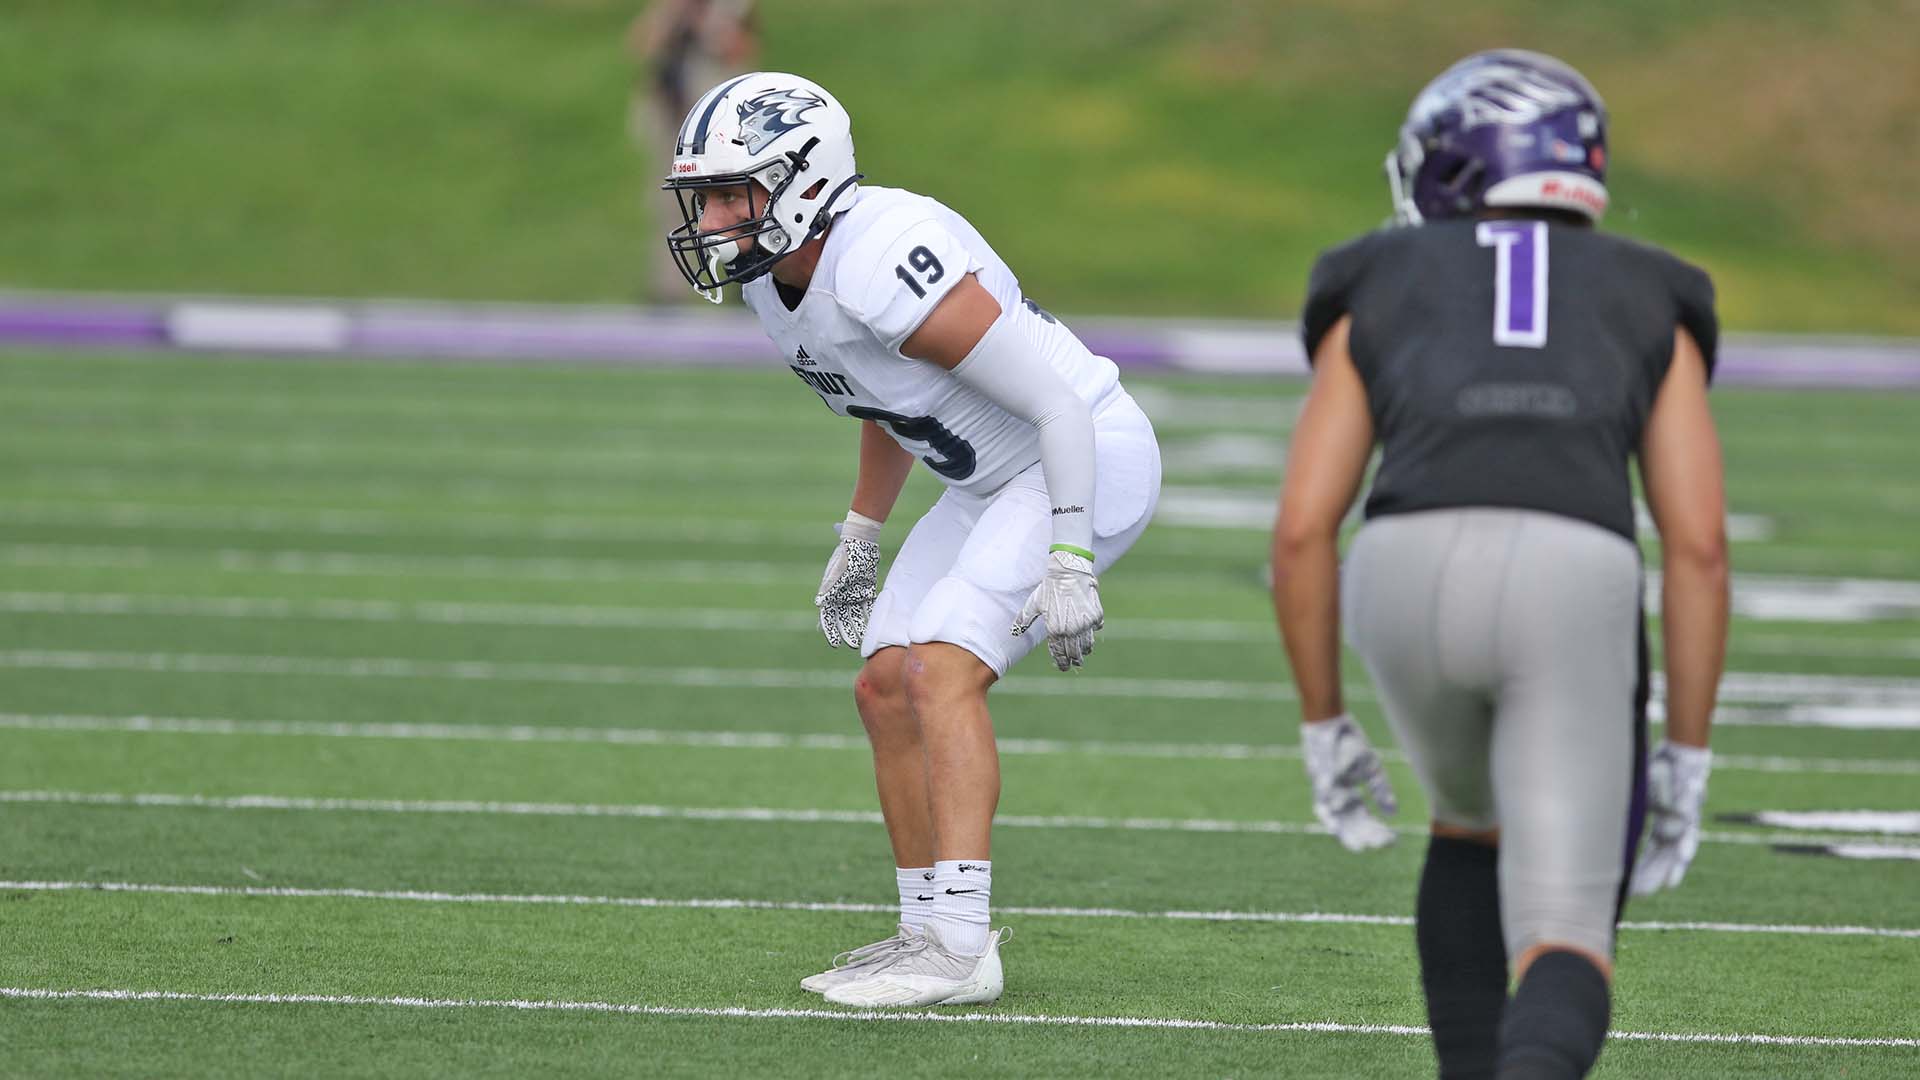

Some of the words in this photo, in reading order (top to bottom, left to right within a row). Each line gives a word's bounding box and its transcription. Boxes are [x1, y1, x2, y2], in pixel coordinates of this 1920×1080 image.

[673, 162, 697, 173] Rddell
[895, 245, 945, 300] 19
[1475, 220, 1549, 348] 1
